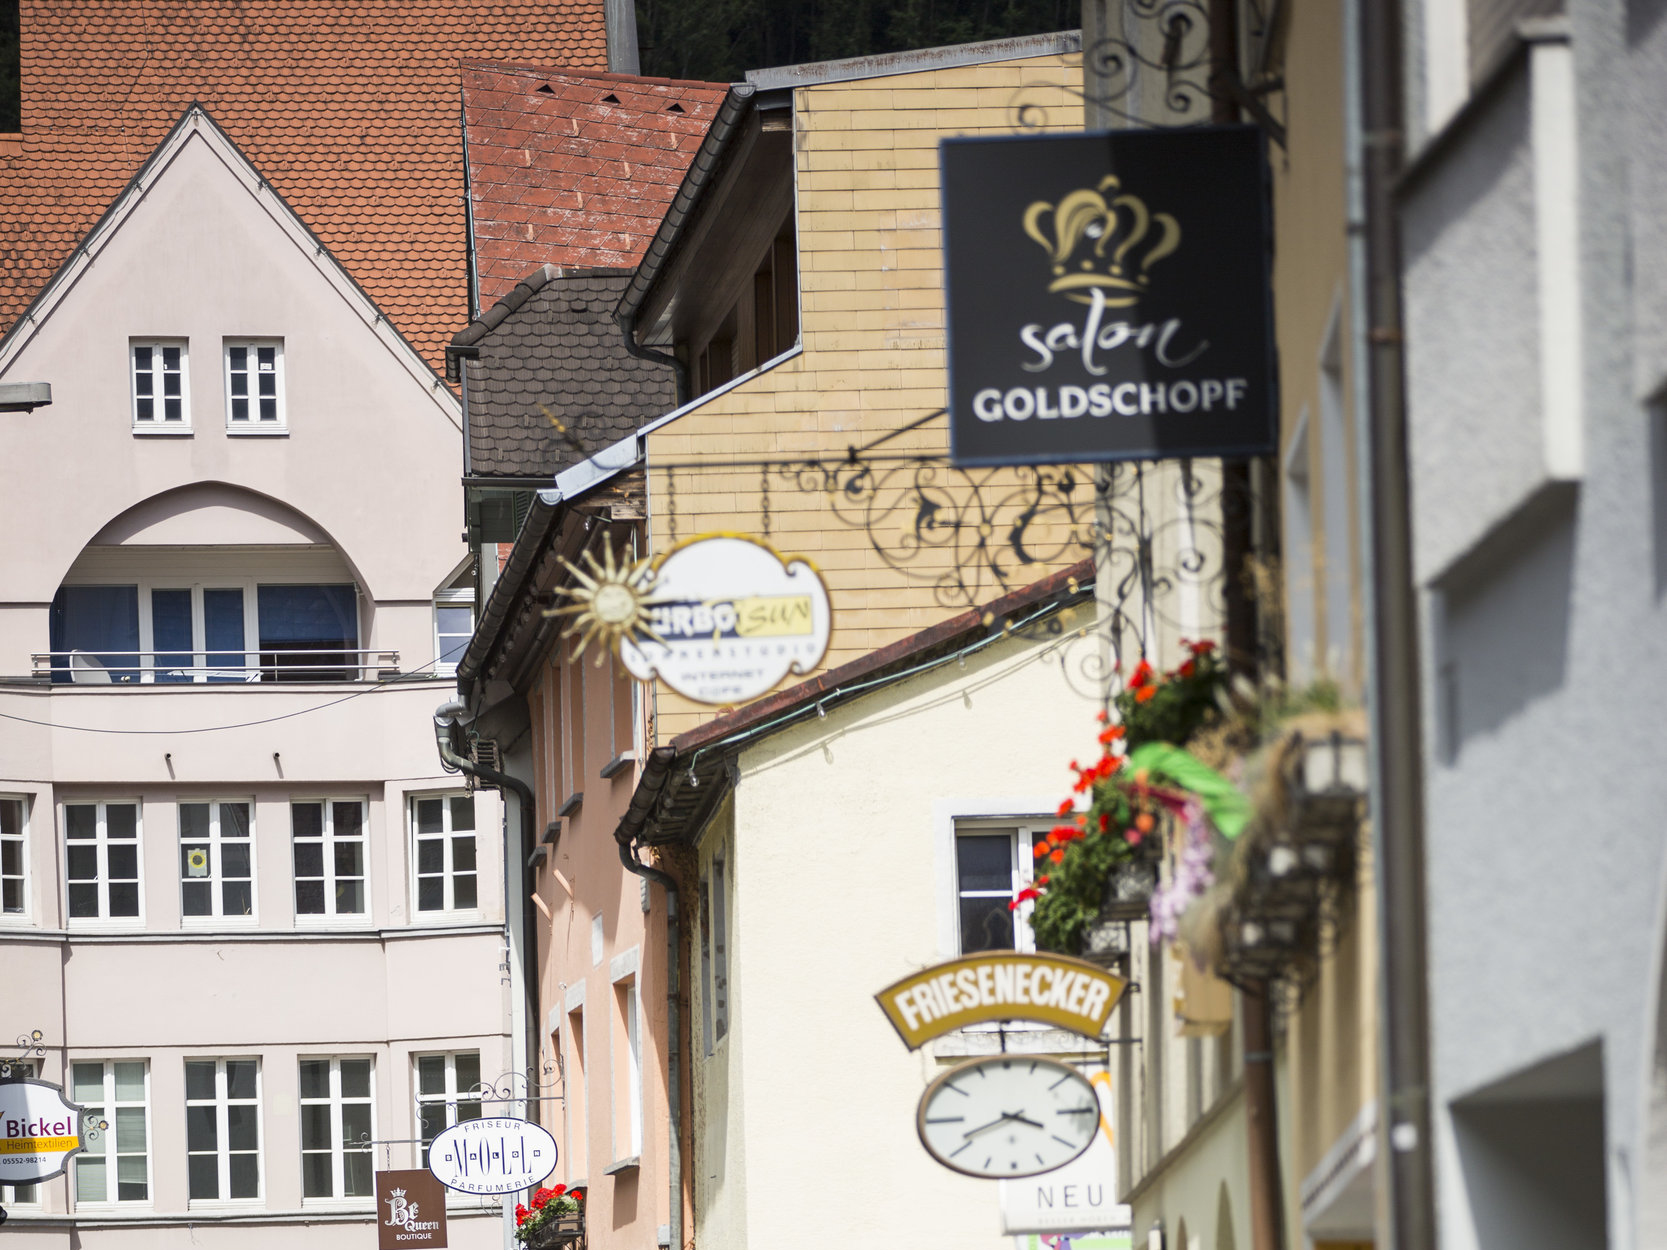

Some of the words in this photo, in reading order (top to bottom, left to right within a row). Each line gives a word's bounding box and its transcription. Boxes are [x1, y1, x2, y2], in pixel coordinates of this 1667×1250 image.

[1020, 286, 1210, 376] salon
[972, 377, 1249, 422] GOLDSCHOPF
[894, 963, 1111, 1031] FRIESENECKER
[6, 1116, 72, 1138] Bickel
[464, 1120, 521, 1133] FRISEUR
[6, 1138, 73, 1151] Heimtextilien
[450, 1175, 536, 1192] PARFUMERIE
[1037, 1184, 1103, 1208] NEU
[384, 1196, 419, 1227] Be
[396, 1232, 433, 1241] BOUTIQUE
[404, 1219, 440, 1233] Queen
